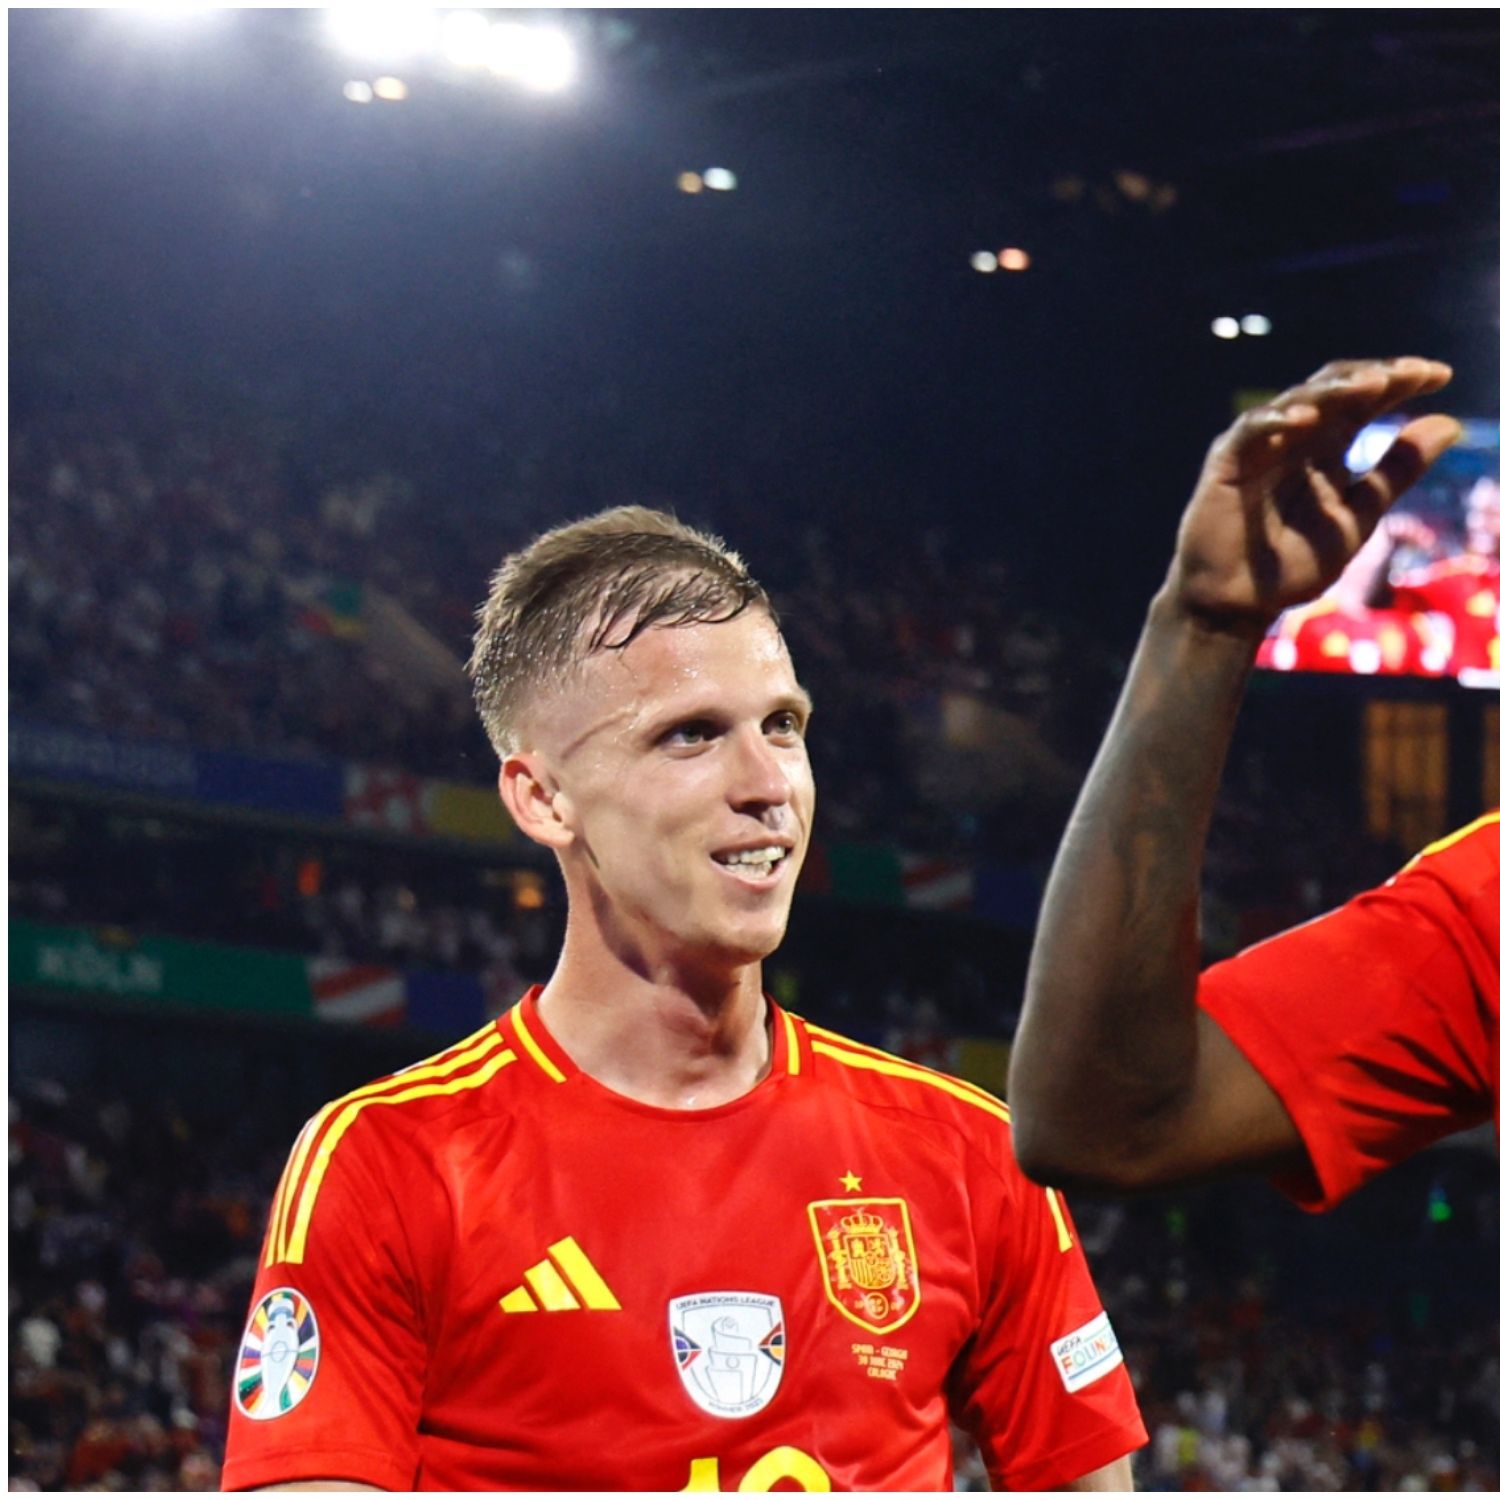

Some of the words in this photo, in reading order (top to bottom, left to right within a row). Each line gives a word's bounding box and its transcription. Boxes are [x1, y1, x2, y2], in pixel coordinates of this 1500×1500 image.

[676, 1300, 698, 1309] UEFA
[699, 1296, 739, 1305] NATIONS
[740, 1297, 775, 1307] LEAGUE
